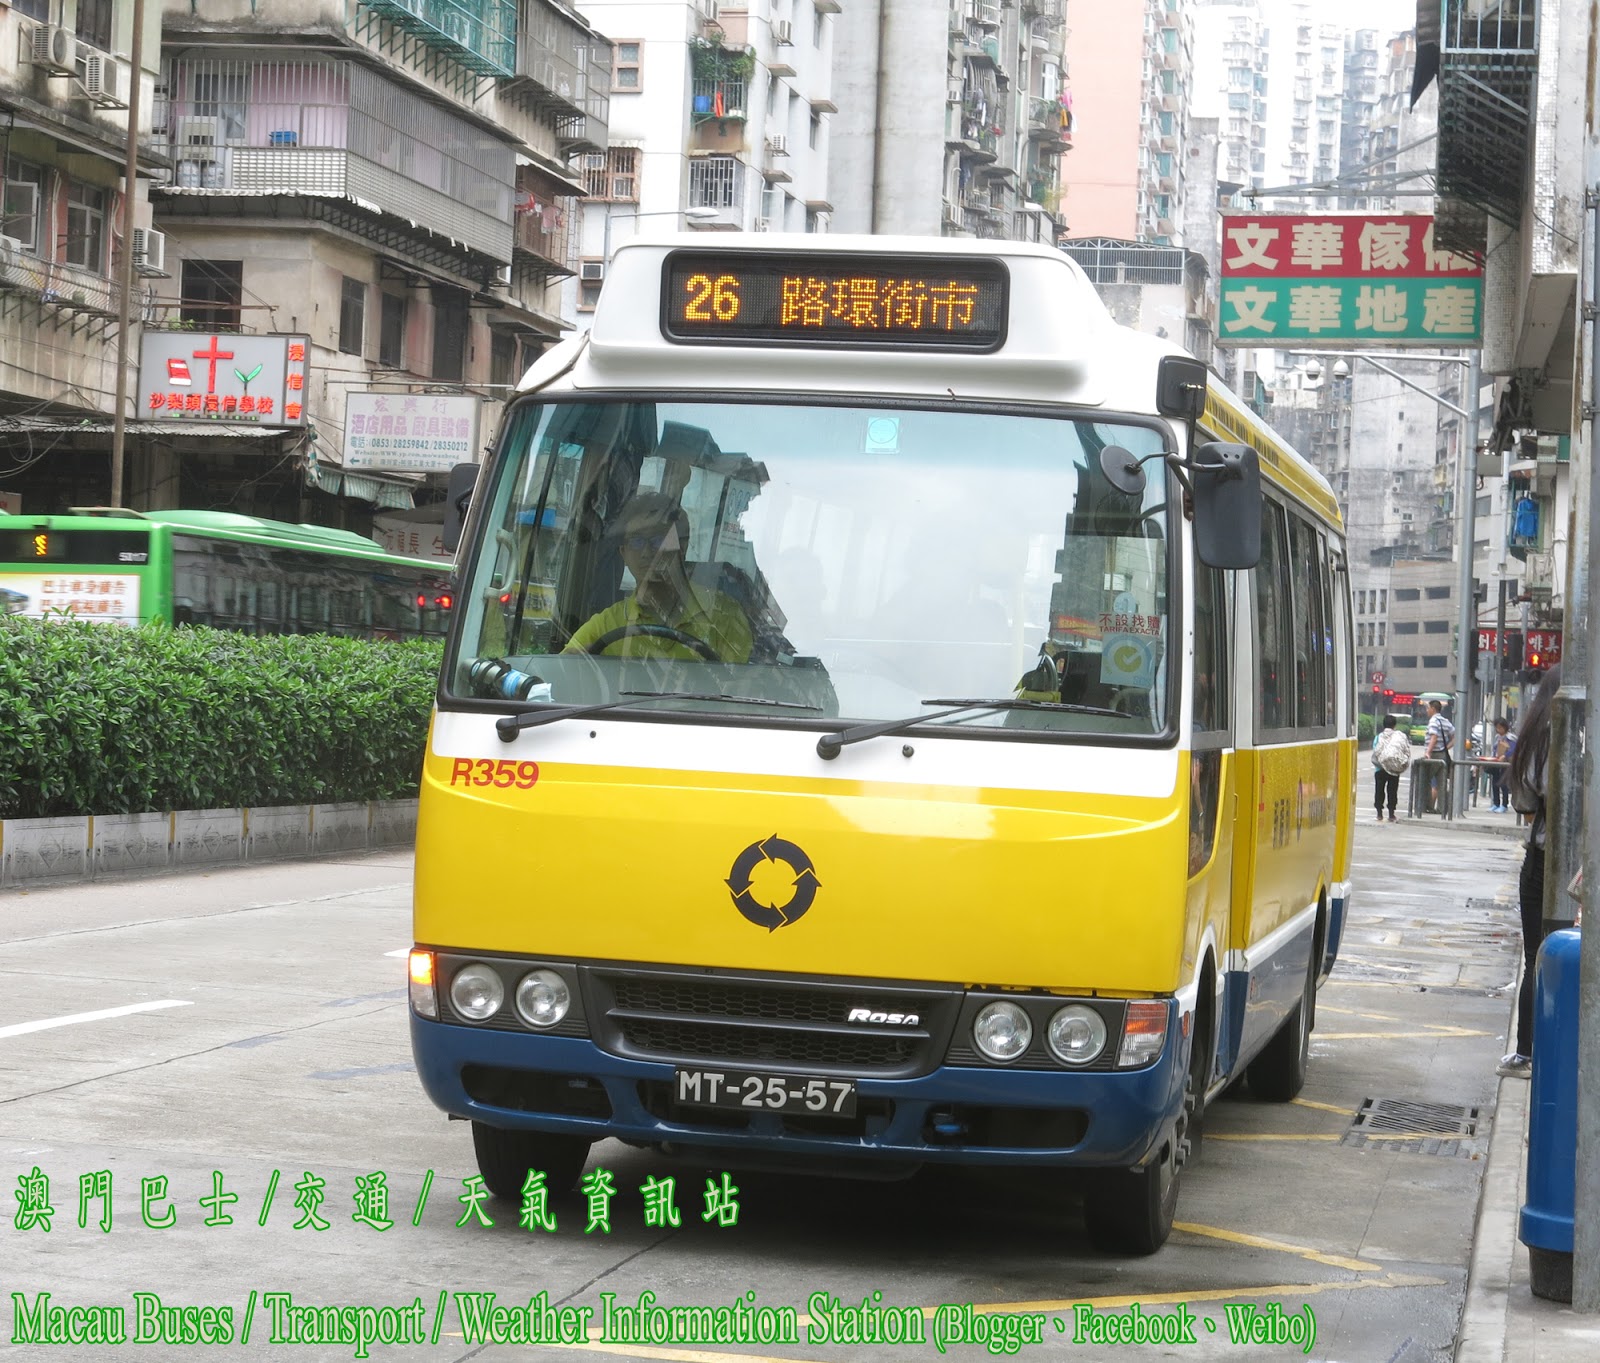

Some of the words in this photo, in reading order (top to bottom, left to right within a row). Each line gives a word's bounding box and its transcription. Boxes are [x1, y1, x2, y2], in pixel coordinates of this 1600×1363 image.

[684, 275, 741, 322] 26
[780, 277, 978, 330] 路環街市
[1224, 285, 1476, 333] 文華地產
[149, 392, 274, 415] 沙梨頭浸信學校
[285, 344, 305, 419] 浸信會
[450, 758, 540, 789] R359
[679, 1070, 851, 1113] MT-25-57
